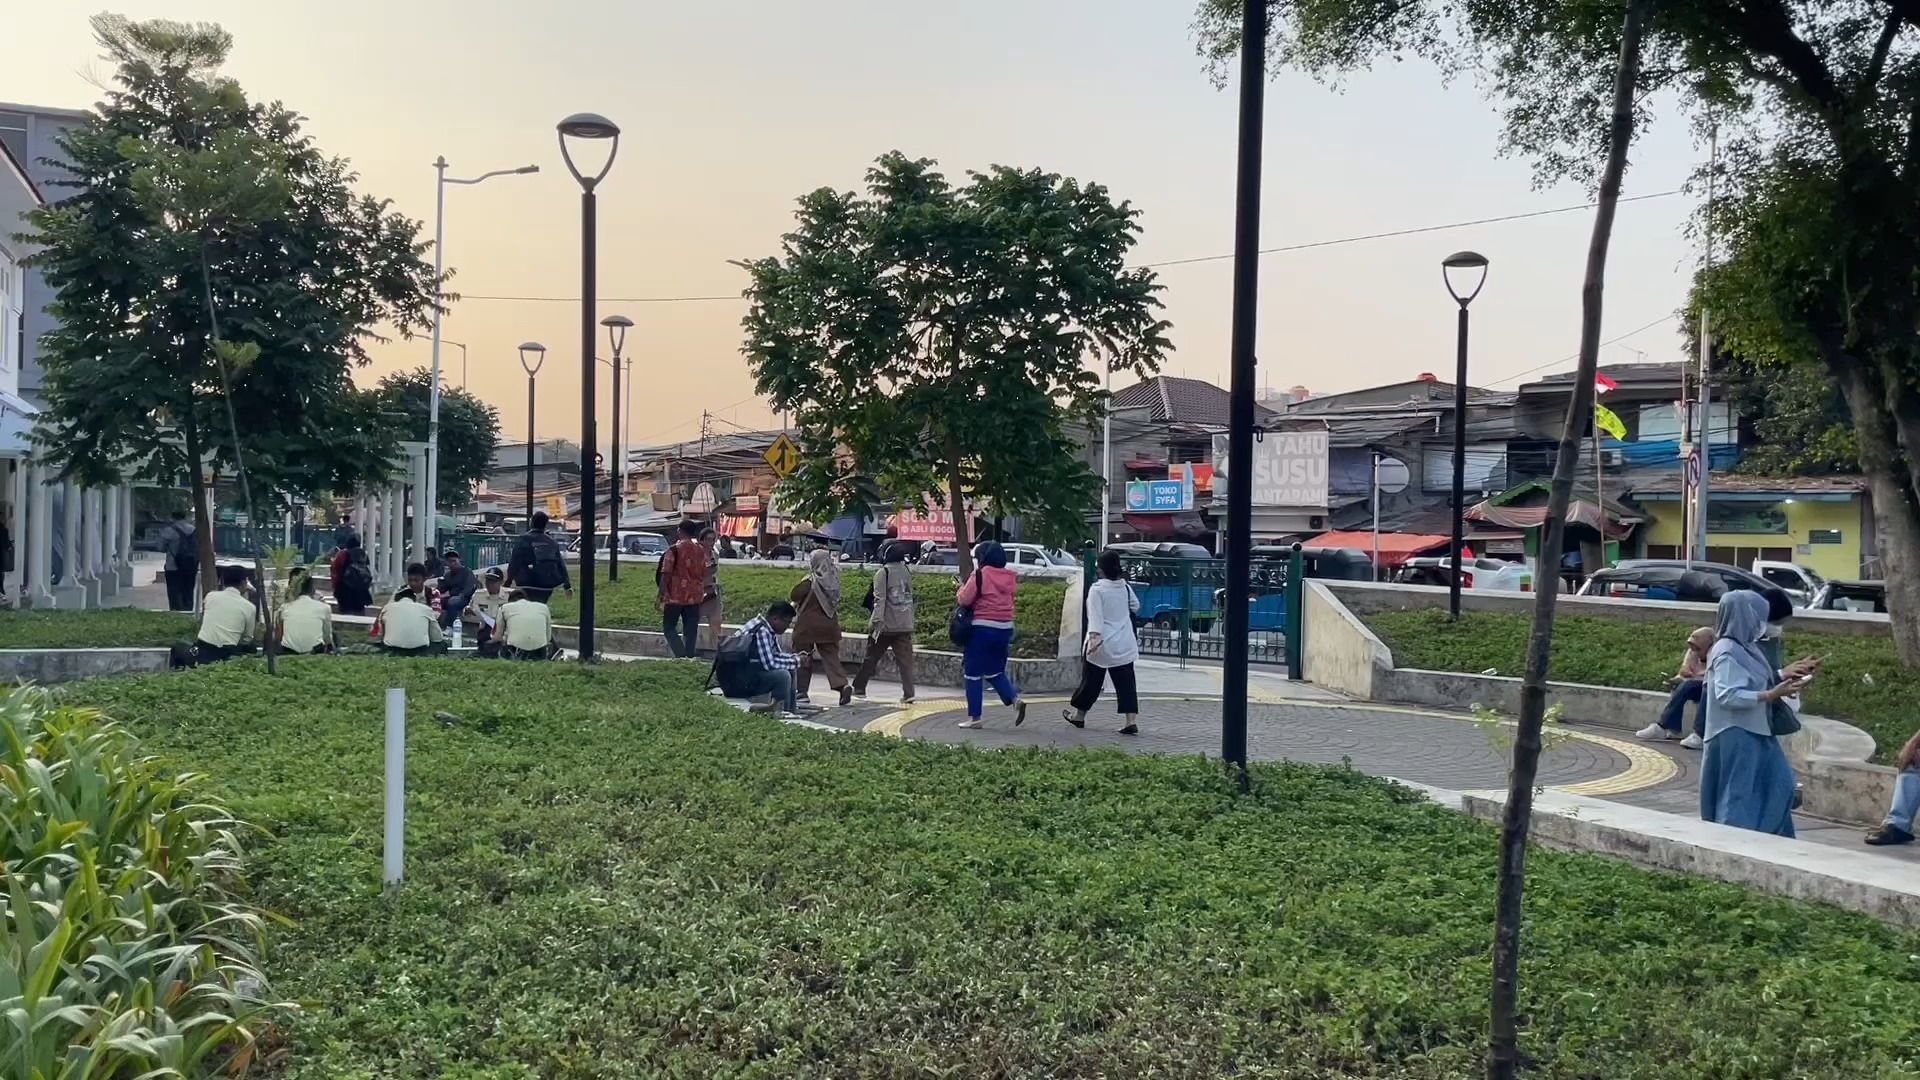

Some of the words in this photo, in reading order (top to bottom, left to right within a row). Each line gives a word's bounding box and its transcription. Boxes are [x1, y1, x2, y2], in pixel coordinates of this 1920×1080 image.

[1272, 435, 1326, 455] TAHU
[1255, 458, 1326, 485] SUSU
[1153, 486, 1177, 495] TOKO
[1155, 496, 1177, 505] SYFA
[901, 511, 937, 523] SOO
[930, 526, 956, 534] BOGO
